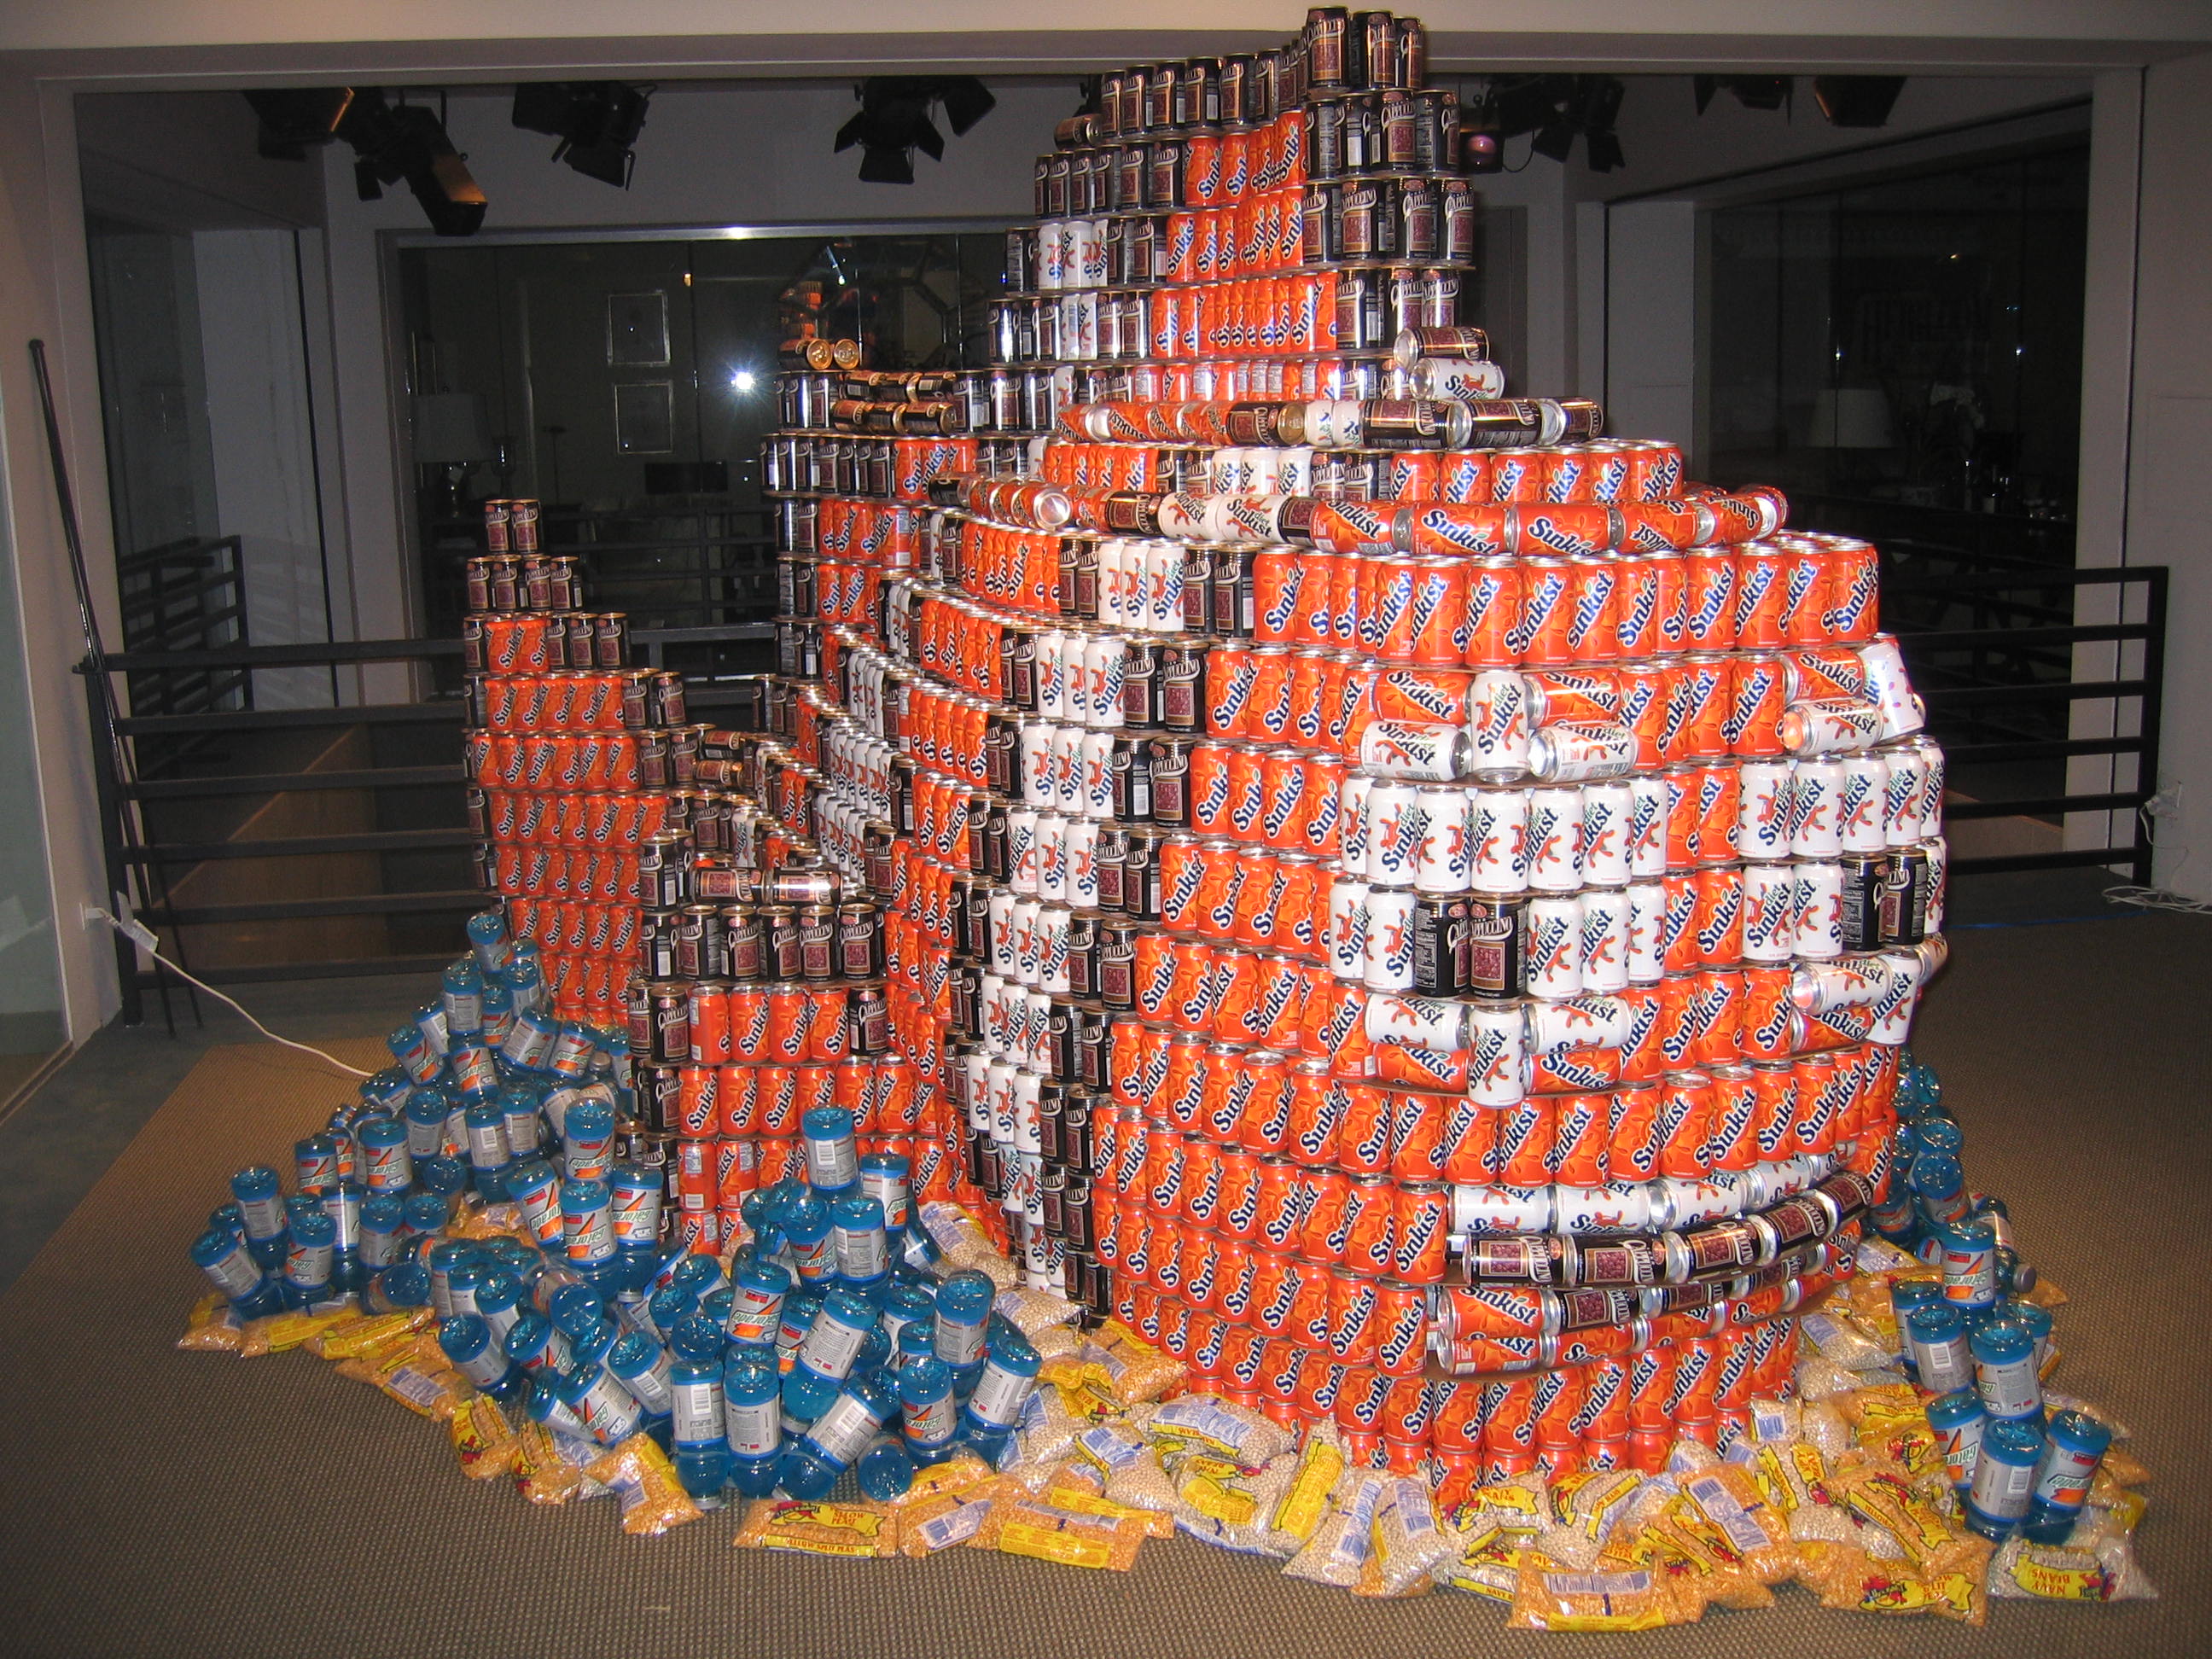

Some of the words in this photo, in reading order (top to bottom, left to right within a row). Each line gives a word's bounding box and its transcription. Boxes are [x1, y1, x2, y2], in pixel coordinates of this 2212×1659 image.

[1174, 492, 1206, 524] Sunkist
[1227, 499, 1272, 537] Sunkist
[1254, 512, 1270, 527] diet
[1329, 501, 1382, 538] Sunkist
[1423, 509, 1499, 554] Sunkist
[1568, 570, 1614, 650] Sunkist
[1617, 568, 1657, 647] Sunkist
[1688, 562, 1734, 640] Sunkist
[1388, 671, 1454, 719] Sunkist
[1494, 683, 1510, 707] diet
[1545, 671, 1619, 712] Sunkist
[1721, 668, 1772, 744] Sunkist
[1799, 653, 1862, 694] Sunkist
[1378, 723, 1436, 766] Sunkist
[1478, 684, 1522, 754] Sunkist
[1264, 765, 1304, 838] Sunkist
[1697, 880, 1745, 953] Sunkist
[1747, 882, 1791, 948] Sunkist
[1765, 882, 1783, 905] diet
[1527, 916, 1569, 982] Sunkist
[1539, 917, 1554, 940] diet
[1259, 969, 1297, 1035] Sunkist
[1469, 1027, 1507, 1091] Sunkist
[1477, 1027, 1494, 1051] diet
[1712, 1087, 1757, 1160] Sunkist
[1758, 1077, 1797, 1152] Sunkist
[1395, 1200, 1441, 1272] Sunkist
[1329, 1285, 1376, 1355] Sunkist
[1380, 1295, 1425, 1366] Sunkist
[2033, 1580, 2066, 1595] NAVY
